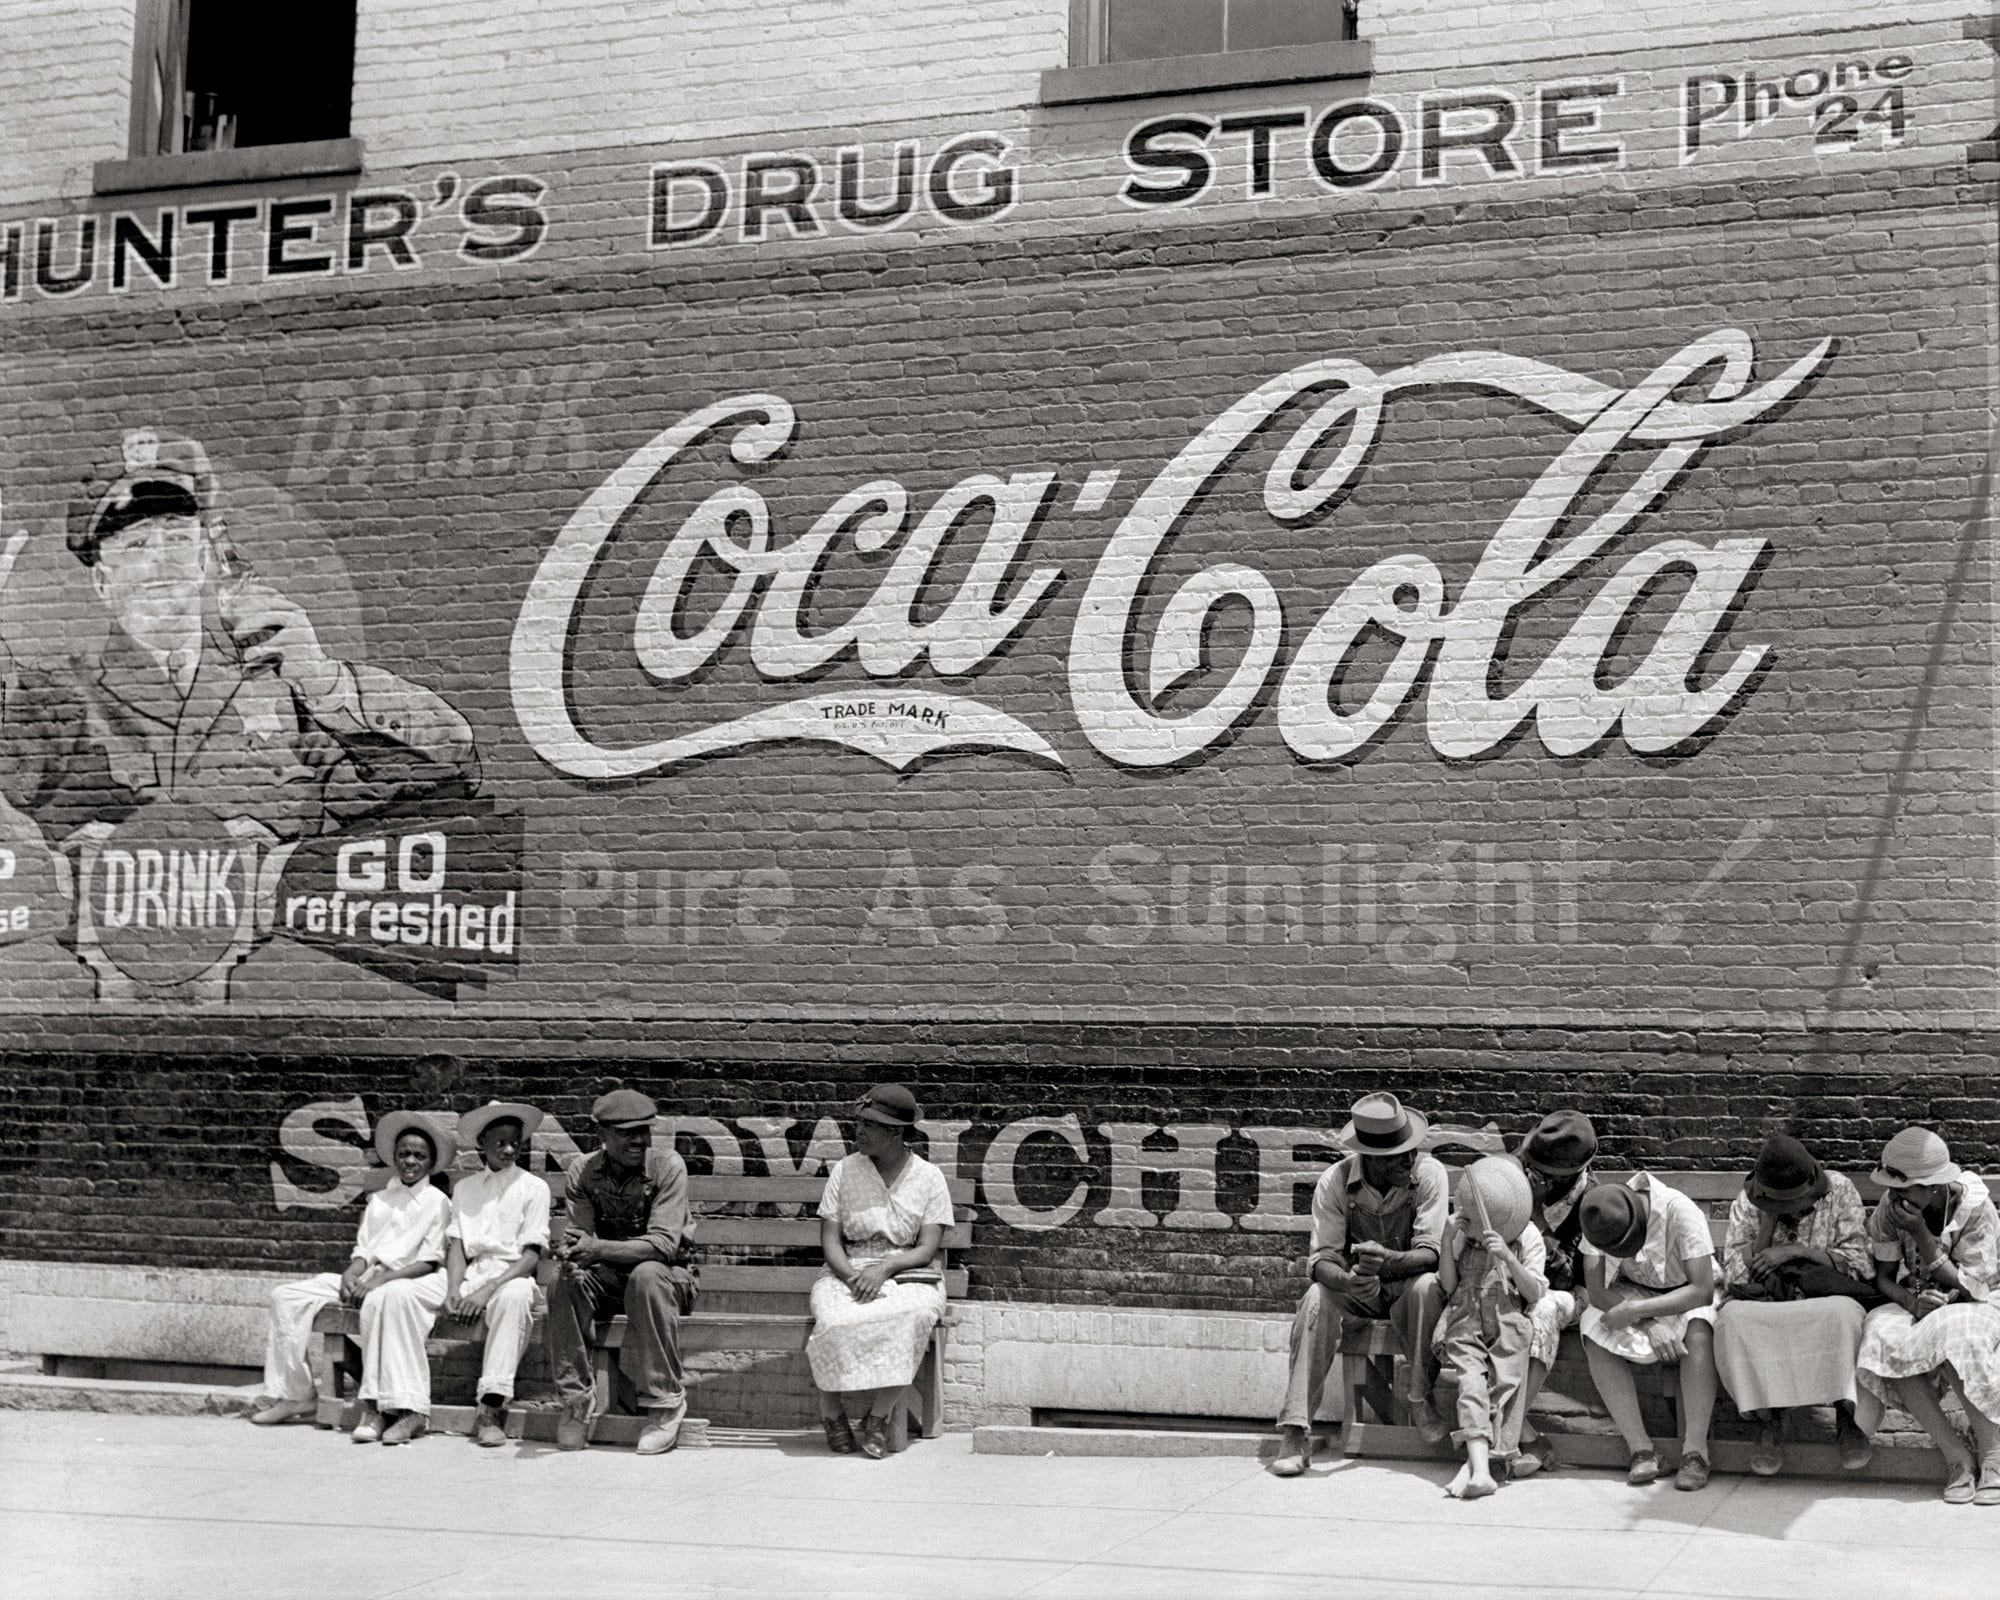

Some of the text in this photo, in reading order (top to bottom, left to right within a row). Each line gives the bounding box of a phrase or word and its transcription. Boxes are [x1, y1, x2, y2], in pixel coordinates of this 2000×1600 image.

[647, 131, 1019, 250] DRUG
[1115, 74, 1626, 209] STORE
[1680, 55, 1914, 164] Phone
[1810, 85, 1916, 153] 24
[288, 362, 606, 486] DRINK
[820, 702, 950, 729] TRADE MARK
[101, 848, 239, 929] DRINK
[336, 831, 447, 894] GO
[285, 890, 515, 954] refreshed
[558, 848, 796, 946] Pure
[858, 847, 1006, 946] As
[1084, 837, 1612, 975] Sunlight
[270, 1096, 1508, 1231] SDWICHE
